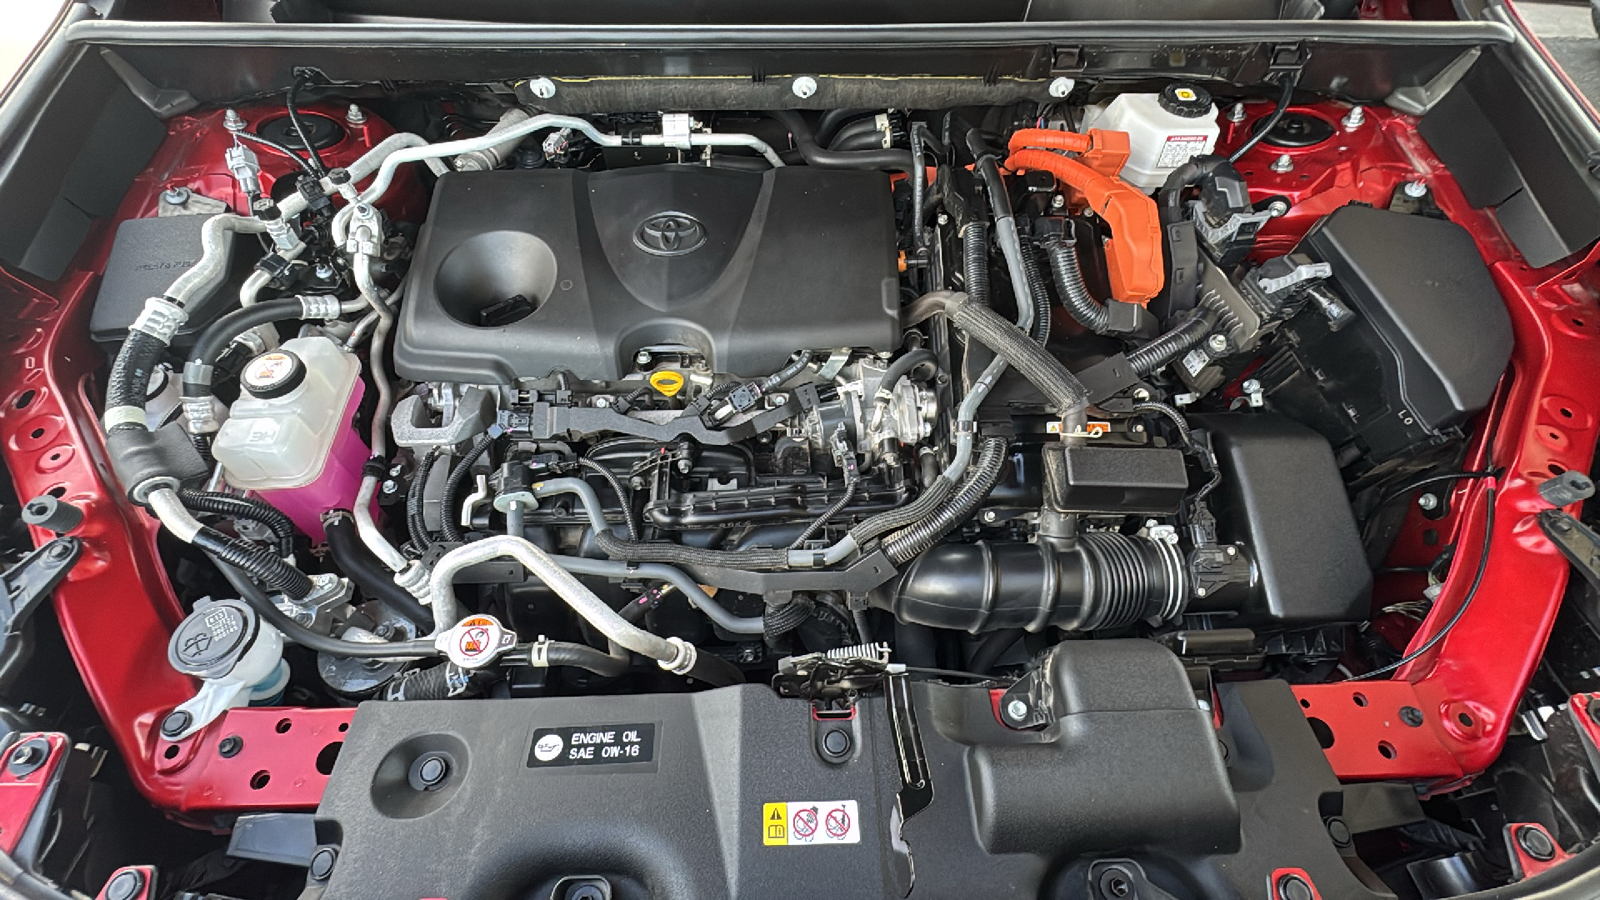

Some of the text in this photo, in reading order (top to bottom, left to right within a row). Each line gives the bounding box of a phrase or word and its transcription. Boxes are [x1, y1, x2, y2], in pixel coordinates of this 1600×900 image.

[571, 730, 641, 745] ENGINE OIL
[569, 745, 640, 759] SAE 0W-16
